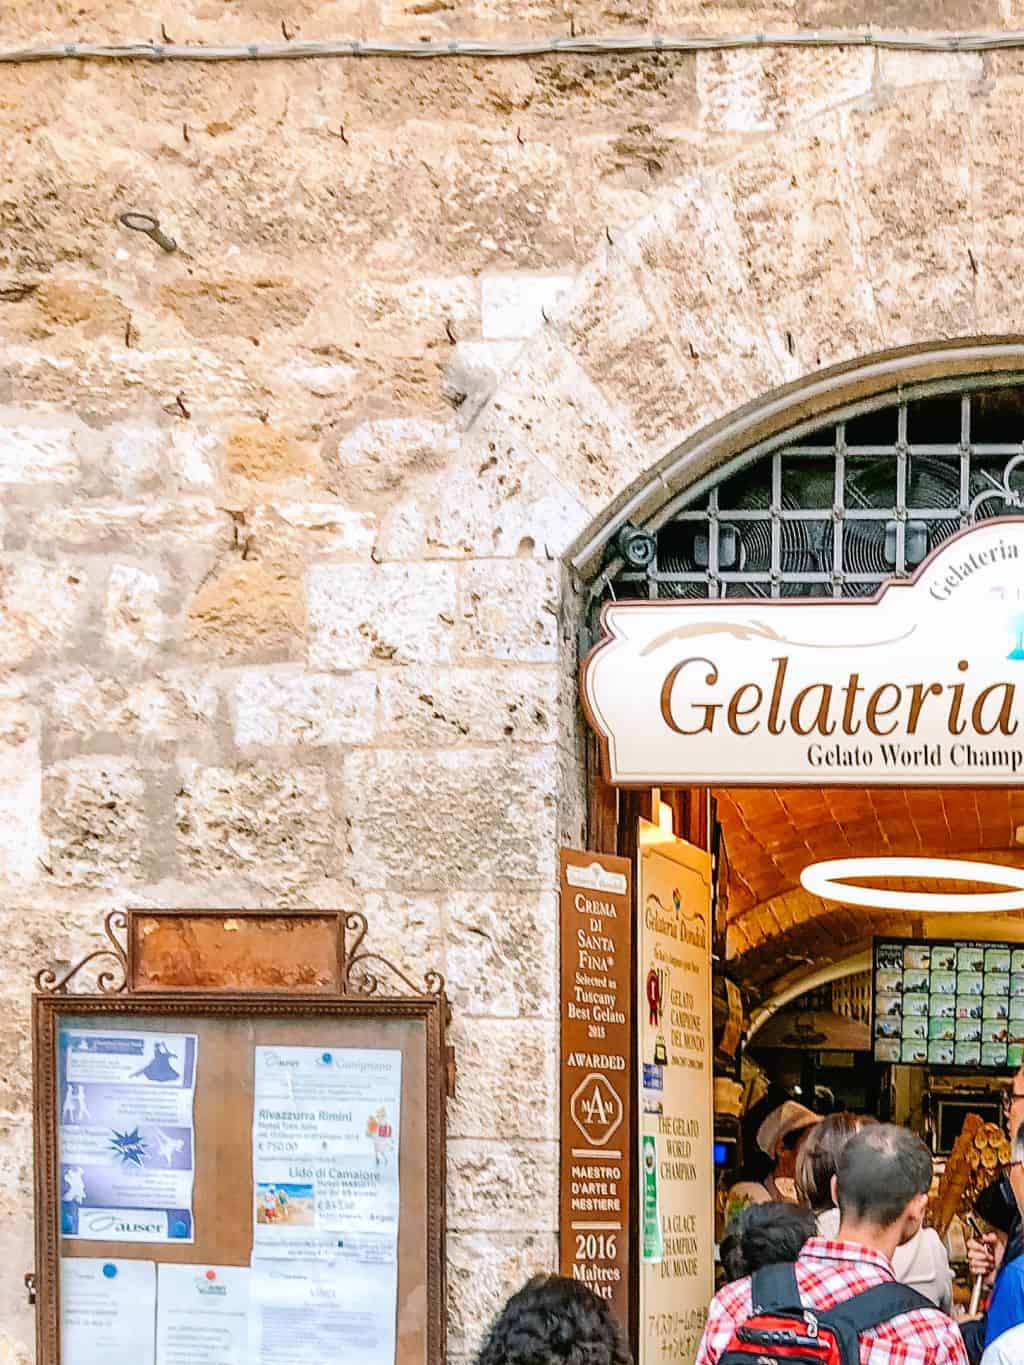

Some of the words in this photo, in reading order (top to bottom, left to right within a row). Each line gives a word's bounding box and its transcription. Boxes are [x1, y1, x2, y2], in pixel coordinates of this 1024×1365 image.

[929, 539, 1019, 600] Gelateria
[660, 656, 1019, 736] Gelateria
[807, 744, 873, 767] Gelato
[880, 744, 942, 767] World
[590, 918, 602, 932] DI
[574, 986, 616, 1010] Tuscany
[568, 1002, 591, 1020] Best
[593, 1005, 626, 1024] Gelato
[568, 1053, 625, 1070] AWARDED
[658, 1115, 671, 1135] THE
[672, 1118, 700, 1138] GELATO
[666, 1139, 691, 1158] WORLD
[289, 1167, 313, 1178] Lido
[315, 1167, 326, 1178] di
[571, 1166, 621, 1180] MAESTRO
[571, 1182, 608, 1195] D'ARTE
[571, 1198, 621, 1211] MESTIERE
[576, 1234, 617, 1260] 2016
